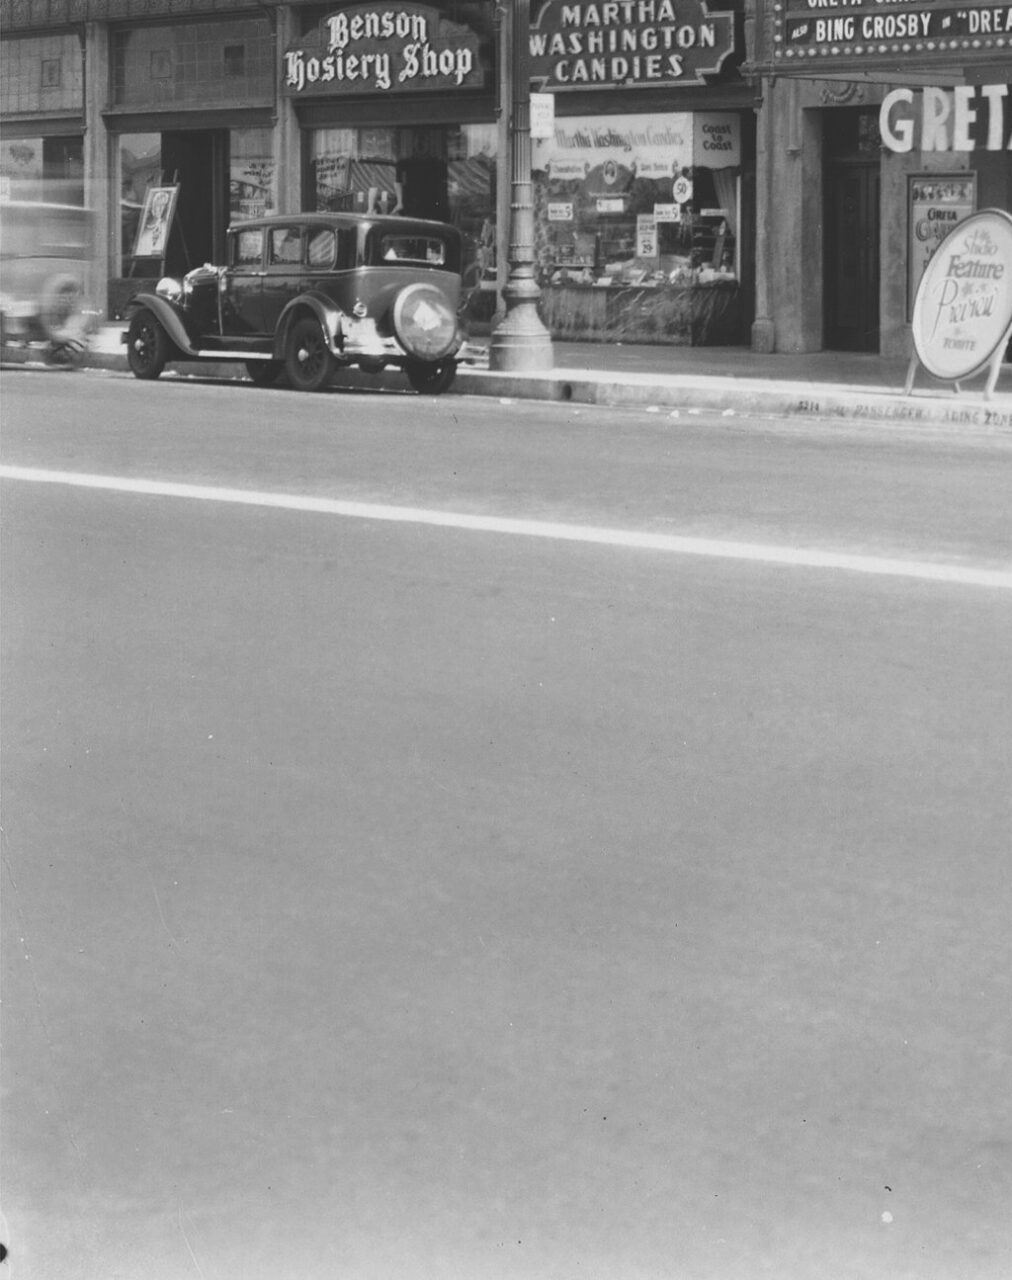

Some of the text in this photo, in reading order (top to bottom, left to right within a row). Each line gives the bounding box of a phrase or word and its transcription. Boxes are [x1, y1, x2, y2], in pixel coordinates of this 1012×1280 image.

[561, 0, 676, 28] MARTHA
[791, 24, 808, 40] ALSO
[815, 17, 854, 42] BING
[862, 13, 931, 39] CROSBY
[328, 12, 427, 53] Benson
[529, 23, 716, 56] WASHINGTON
[284, 43, 472, 91] Hosiery Shop
[555, 54, 683, 82] CANDIES
[702, 123, 731, 134] Coast
[711, 133, 722, 142] to
[703, 140, 733, 151] Coast
[947, 255, 1005, 280] Feature
